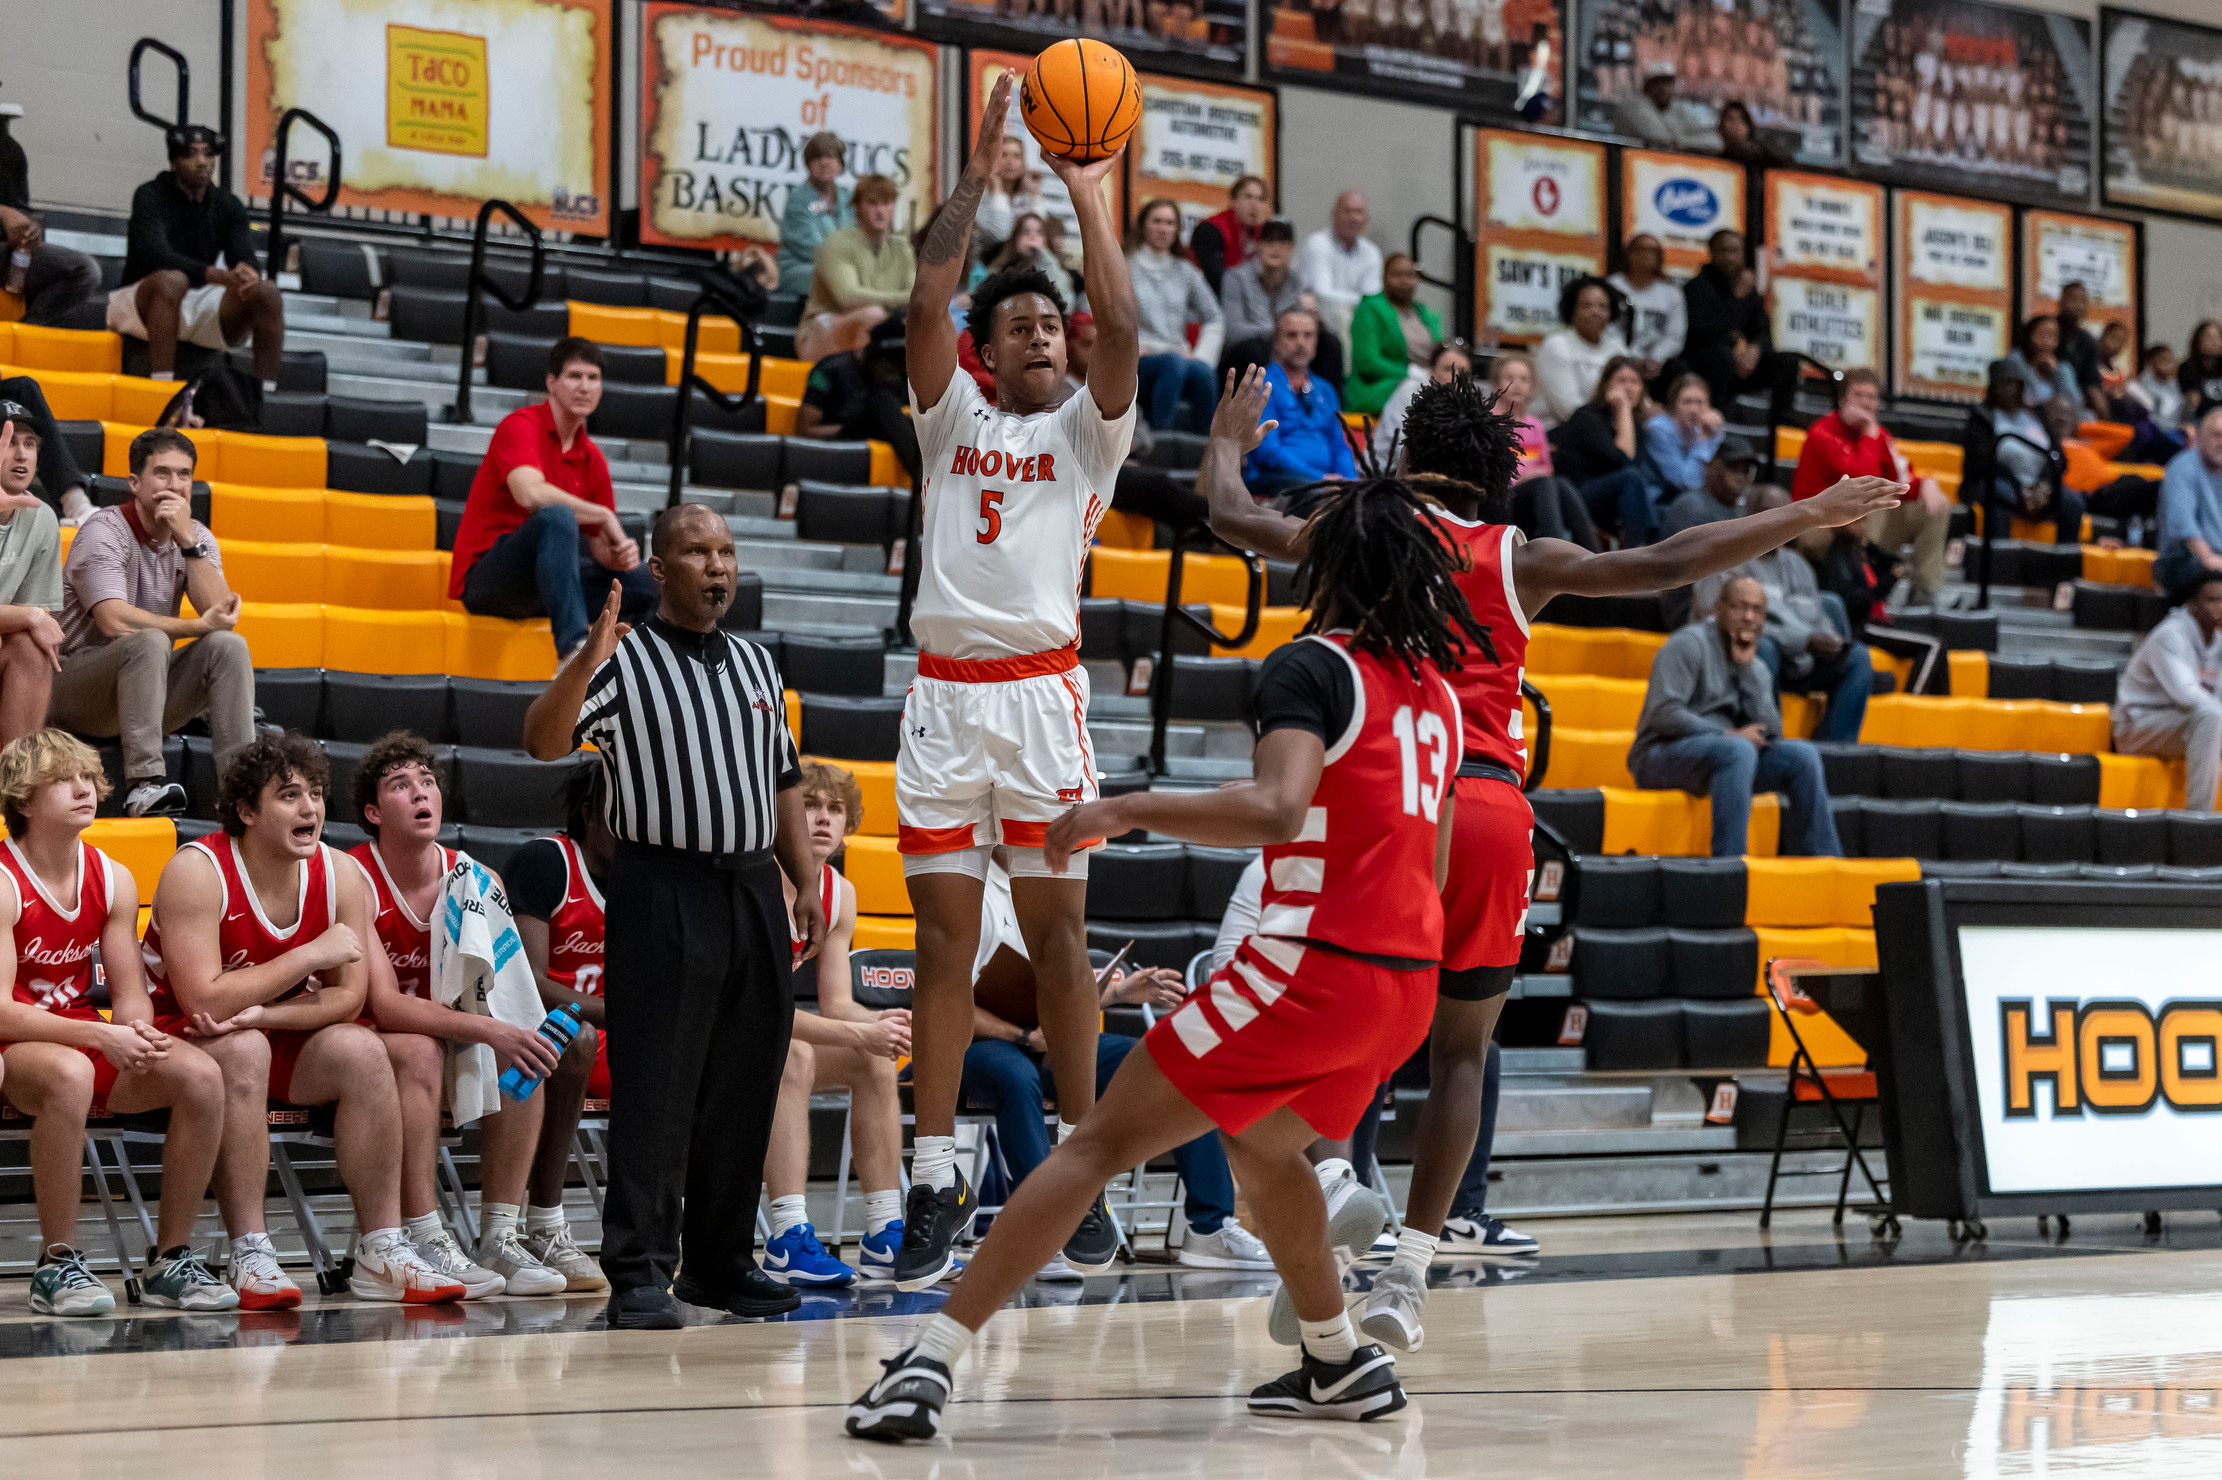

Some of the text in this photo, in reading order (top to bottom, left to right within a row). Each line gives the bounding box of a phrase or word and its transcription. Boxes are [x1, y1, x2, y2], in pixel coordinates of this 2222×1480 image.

[692, 32, 918, 99] Proud Sponsors
[411, 98, 468, 120] MAMA
[801, 92, 831, 127] of
[694, 121, 804, 173] LADY
[950, 443, 1057, 483] HOOVER
[976, 489, 1004, 545] 5
[1393, 705, 1448, 824] 13
[1998, 996, 2222, 1121] HOO
